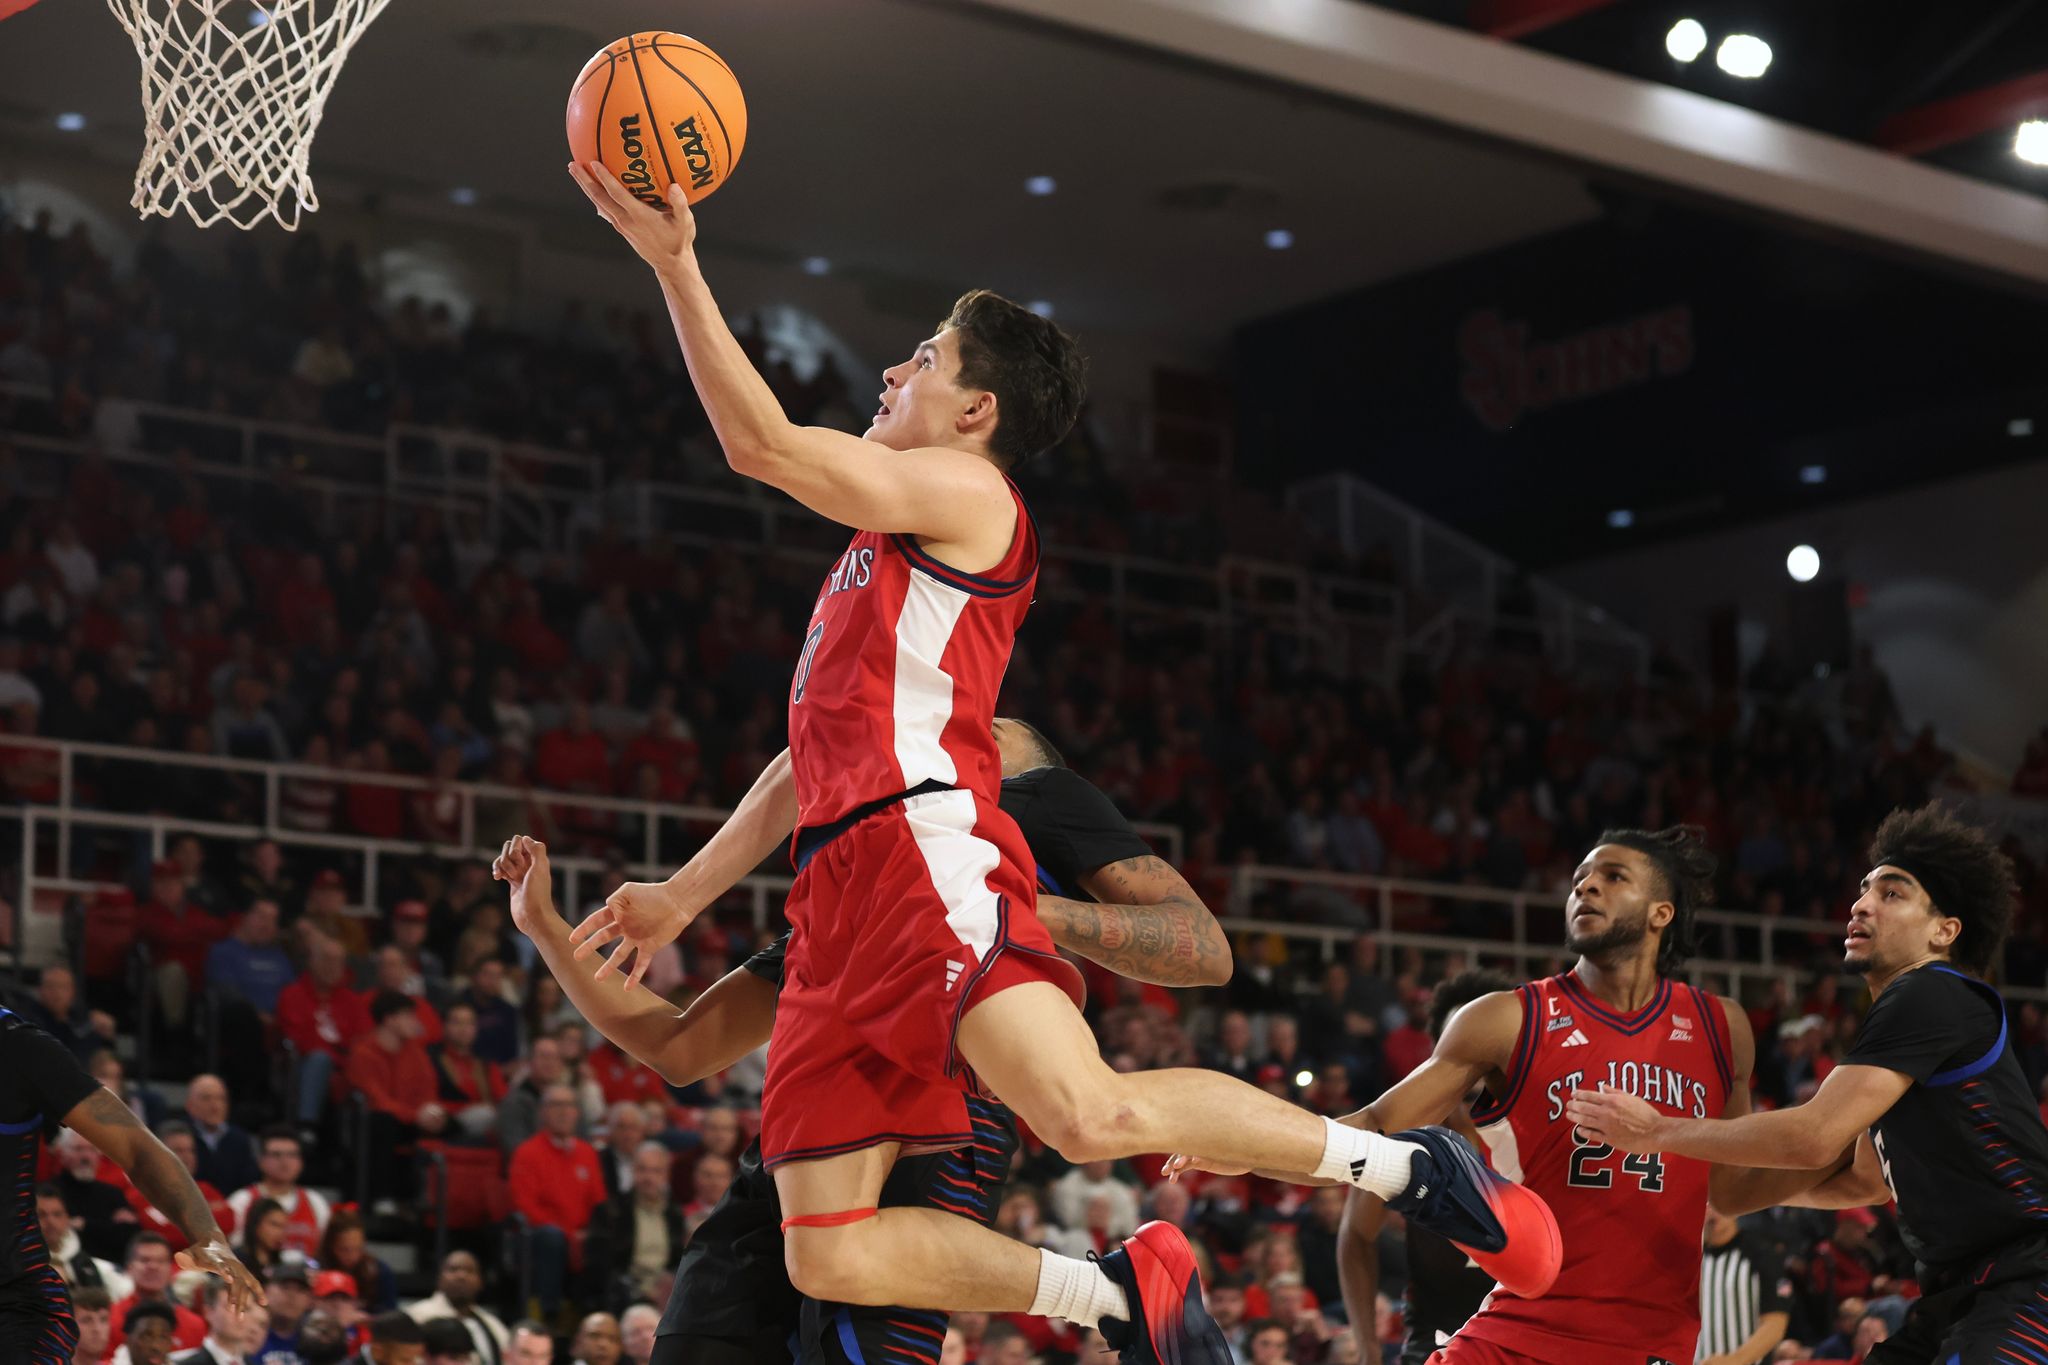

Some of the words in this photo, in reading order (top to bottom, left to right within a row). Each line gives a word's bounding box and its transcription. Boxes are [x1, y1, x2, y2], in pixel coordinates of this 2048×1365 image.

[672, 115, 714, 191] NCAA
[1548, 997, 1561, 1016] C
[1597, 1061, 1706, 1119] JOHN'S
[1567, 1122, 1665, 1193] 24
